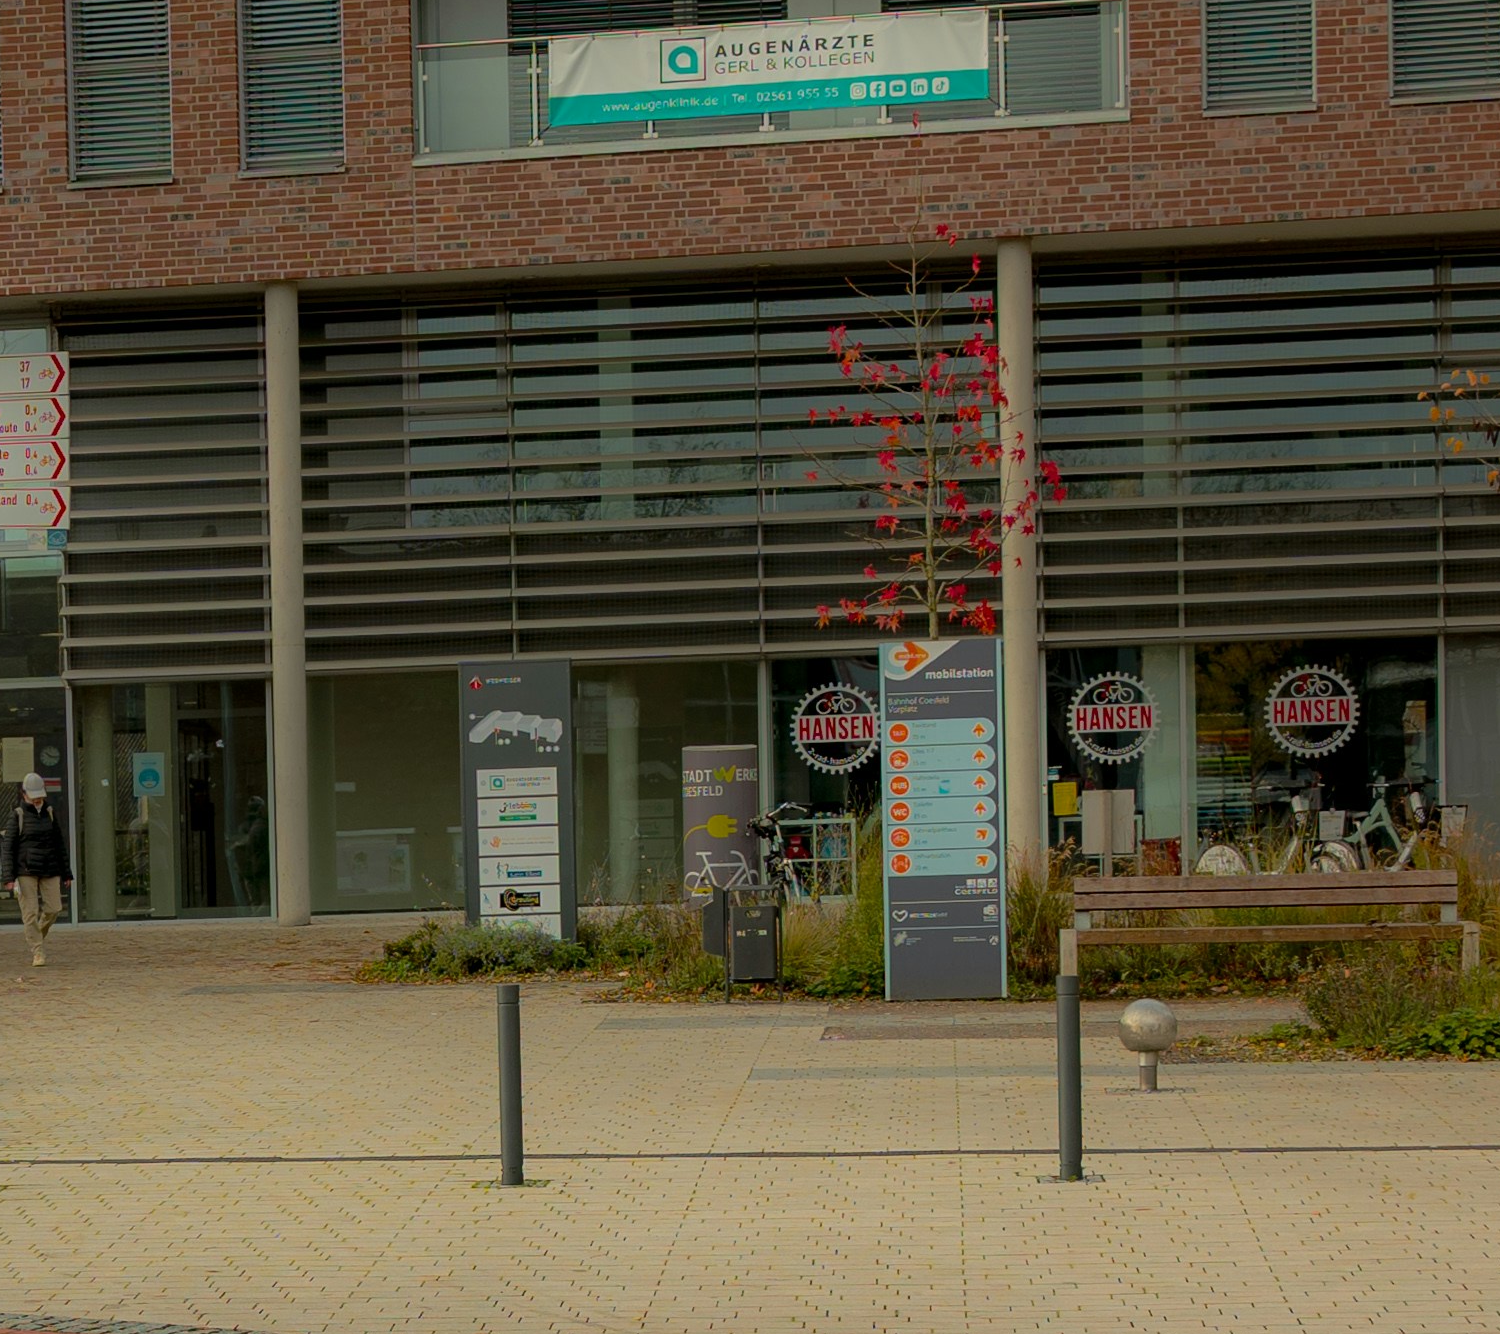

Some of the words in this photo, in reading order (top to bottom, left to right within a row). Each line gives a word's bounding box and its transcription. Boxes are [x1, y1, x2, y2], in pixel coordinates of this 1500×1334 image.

[715, 33, 875, 58] AUGENÄRZTE
[714, 60, 758, 76] GERL
[766, 58, 777, 70] &
[783, 51, 875, 69] KOLLEGEN
[601, 97, 719, 114] www.augenklinik.de
[756, 91, 792, 102] 02561
[797, 89, 820, 99] 955
[824, 87, 839, 97] 55
[19, 361, 30, 373] 37
[20, 378, 30, 389] 17
[925, 668, 994, 680] mobilstation
[918, 695, 950, 704] Coesfeld
[1273, 698, 1351, 725] HANSEN
[799, 715, 874, 741] HANSEN
[1076, 705, 1153, 731] HANSEN
[893, 808, 908, 817] WC
